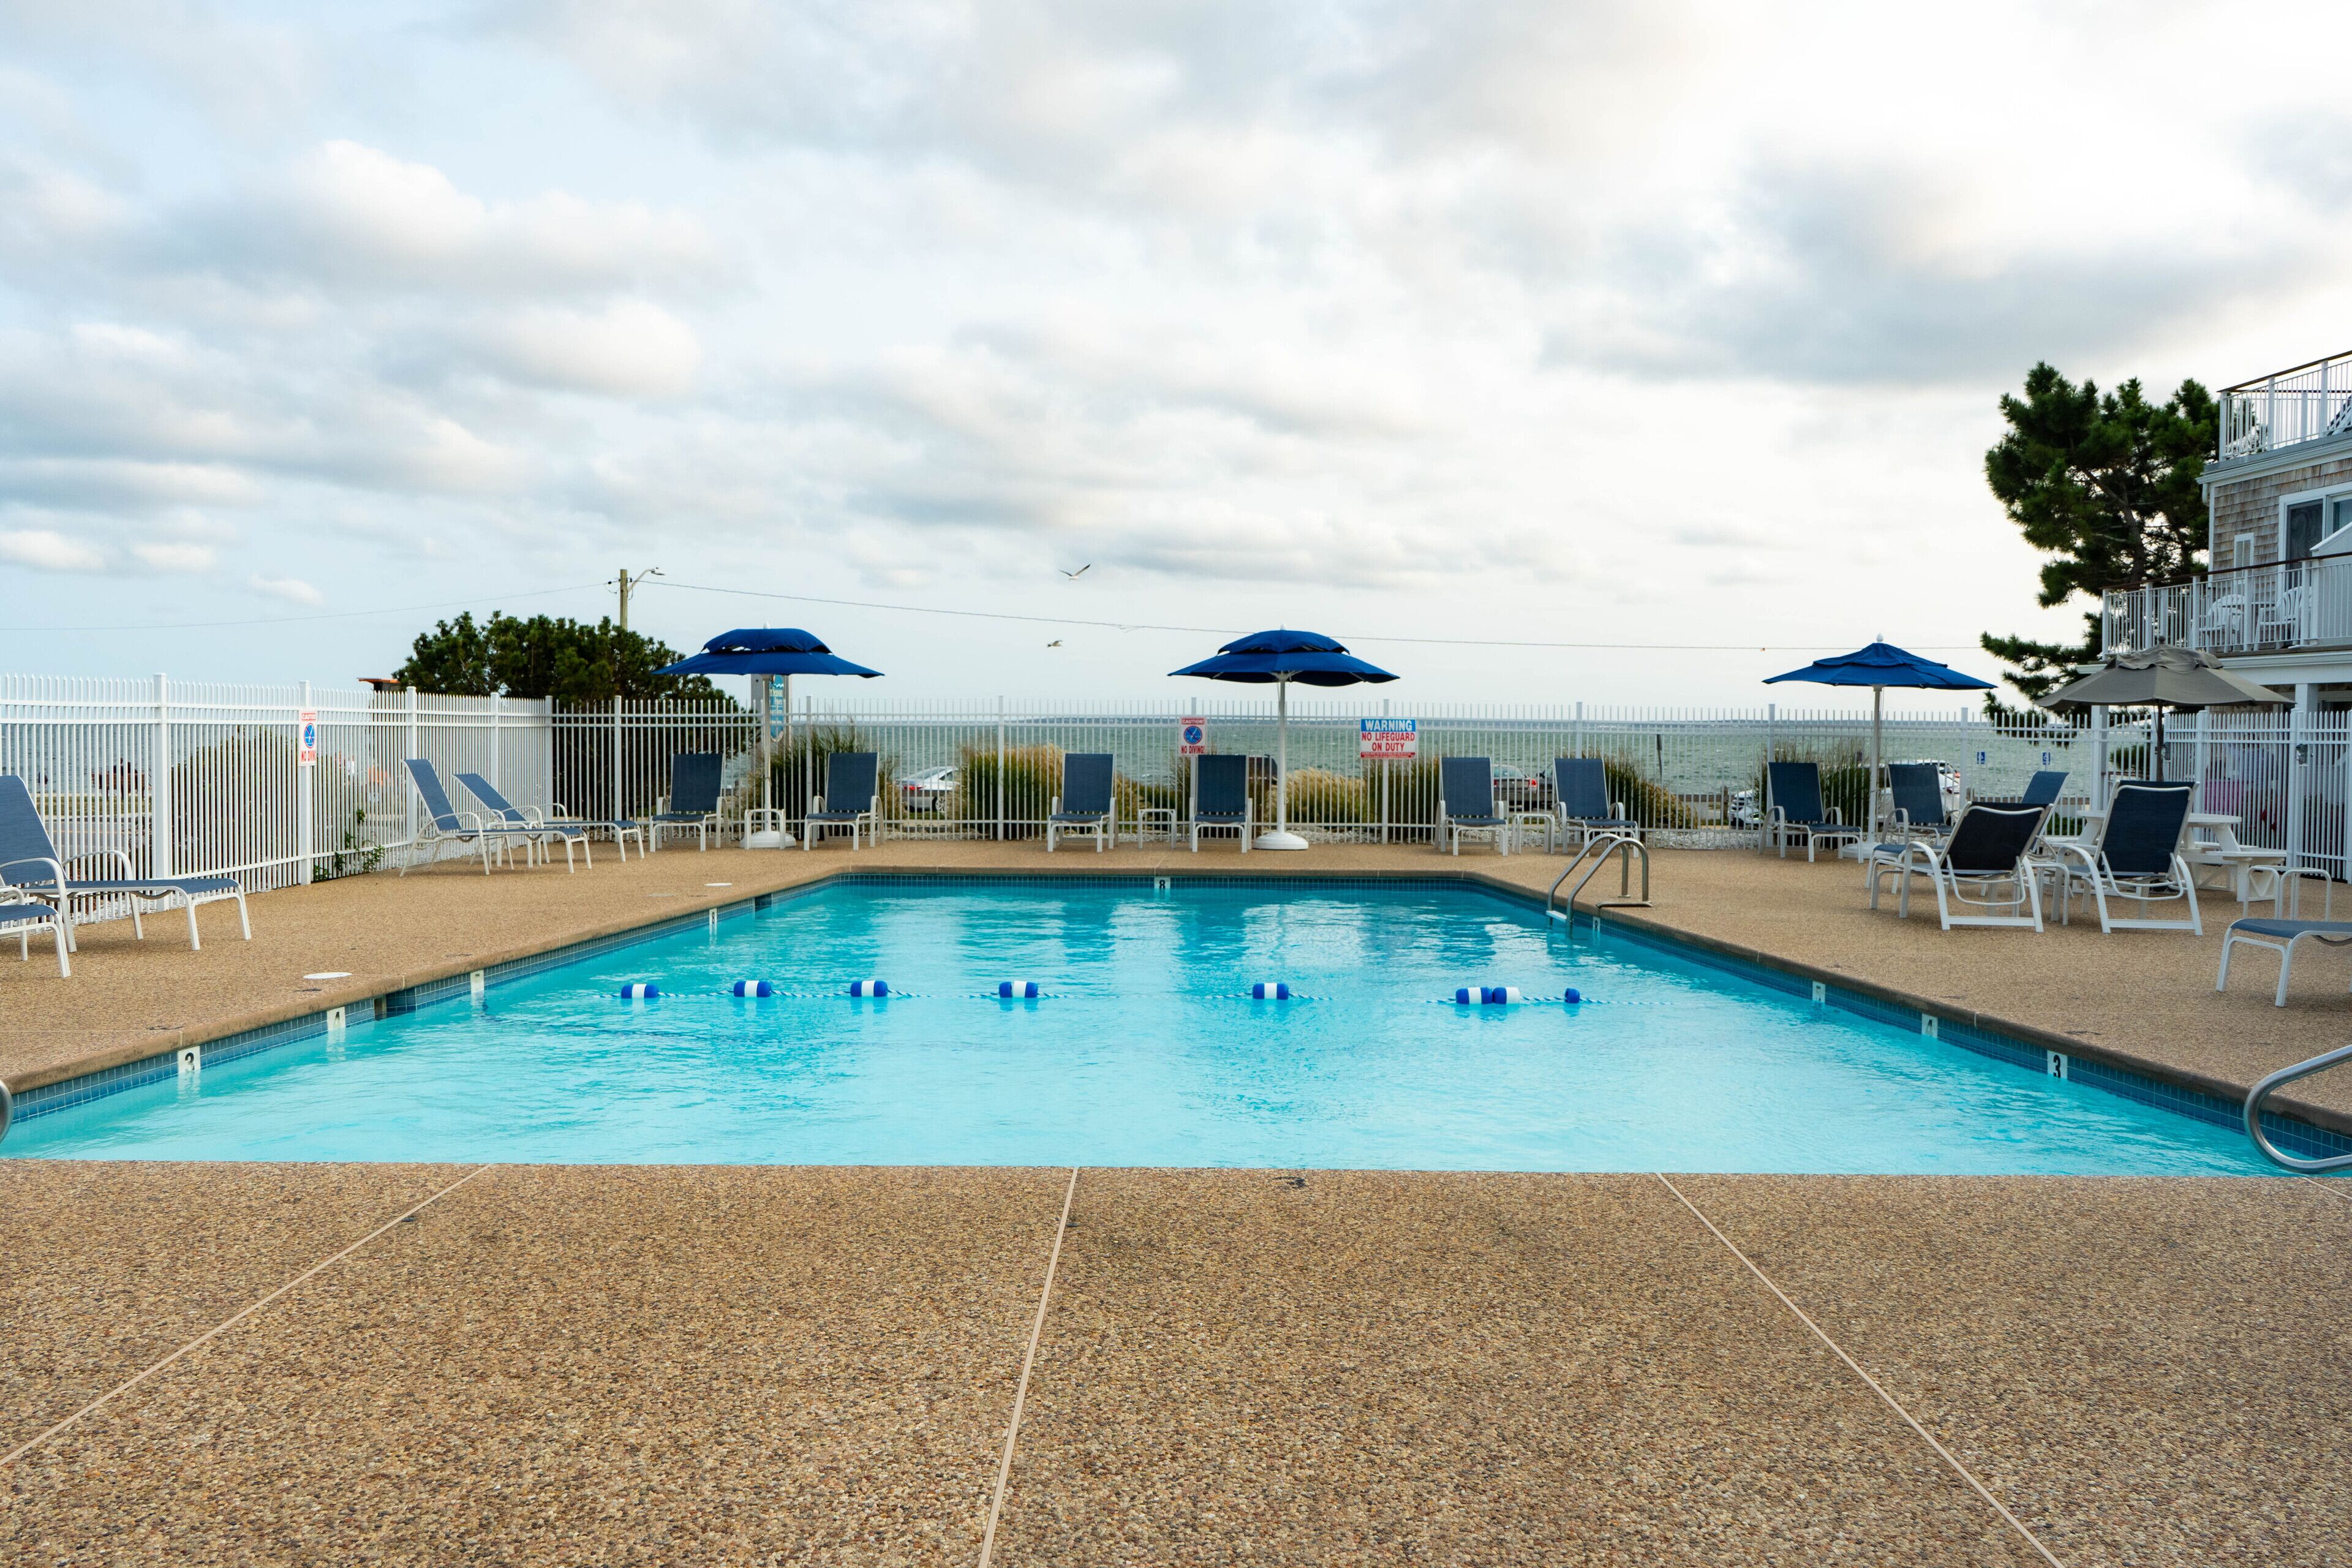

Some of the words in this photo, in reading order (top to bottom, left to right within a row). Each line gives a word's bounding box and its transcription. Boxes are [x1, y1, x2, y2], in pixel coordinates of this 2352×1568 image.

[1365, 720, 1412, 731] WARNING
[1362, 732, 1372, 741] NO
[1375, 732, 1415, 741] LIFEGUARD
[1181, 745, 1188, 754] NO
[1372, 742, 1382, 751] ON
[1385, 742, 1404, 751] DUTY
[301, 750, 306, 761] NO
[1159, 880, 1166, 889] 8
[712, 911, 715, 924] 8
[2053, 1054, 2061, 1078] 3
